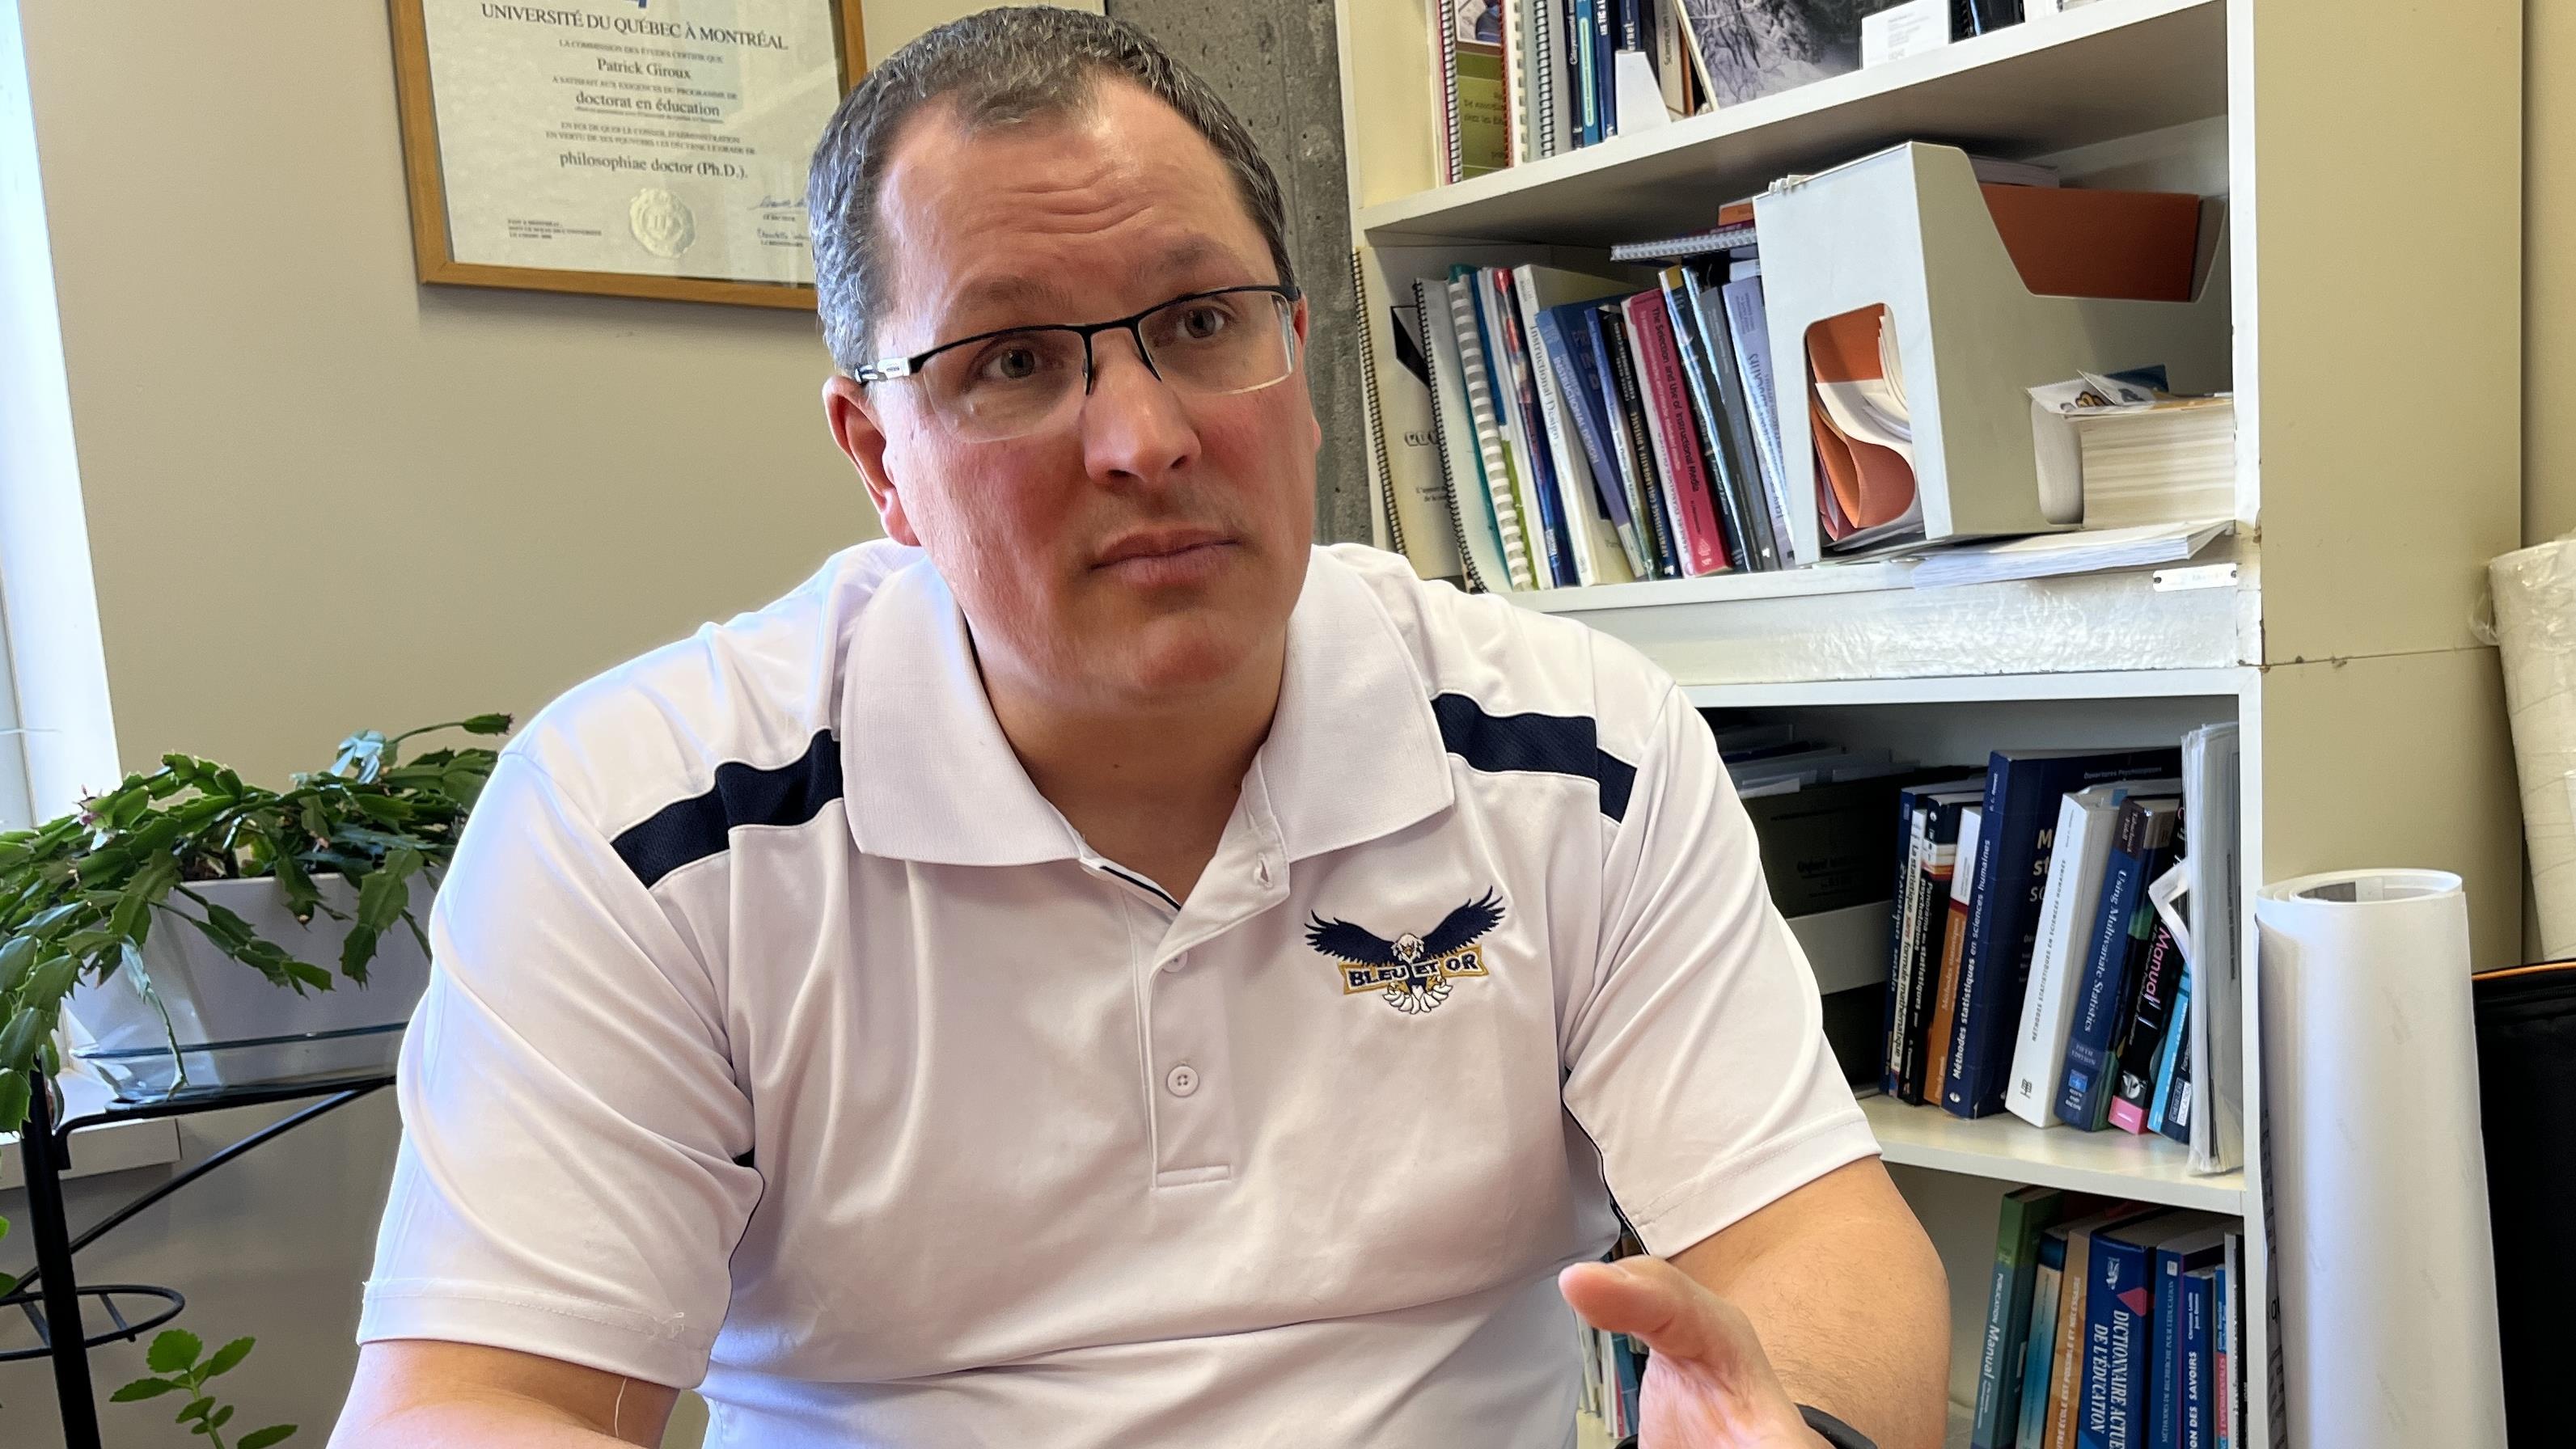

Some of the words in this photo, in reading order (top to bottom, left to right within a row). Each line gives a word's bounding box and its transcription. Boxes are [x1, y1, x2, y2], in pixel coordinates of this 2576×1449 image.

[482, 3, 585, 27] UNIVERSITÉ
[587, 15, 611, 29] DU
[614, 17, 682, 38] QUÉBEC
[685, 22, 697, 40] À
[700, 27, 789, 50] MONTRÉAL
[597, 58, 641, 76] Patrick
[646, 63, 692, 79] Giroux
[576, 91, 632, 108] doctorat
[636, 99, 652, 110] en
[656, 98, 720, 117] éducation
[560, 151, 647, 171] philosophiae
[650, 158, 692, 175] doctor
[696, 162, 748, 180] (Ph.D.).
[1650, 306, 1662, 323] The
[1653, 324, 1672, 362] Selection
[1527, 323, 1554, 395] Instructional
[1543, 400, 1563, 439] Design
[1664, 365, 1676, 382] and
[1668, 382, 1680, 399] Use
[1550, 357, 1587, 427] INSTRUCTIONAL
[1580, 429, 1600, 463] DESIGN
[1672, 399, 1681, 409] of
[1673, 412, 1695, 463] Instructional
[1686, 465, 1701, 492] Media
[1911, 844, 1918, 855] La
[2037, 828, 2053, 849] M
[1905, 858, 1918, 912] statistique
[1977, 839, 1990, 890] humaines
[2054, 860, 2066, 898] HUMAINES
[1922, 882, 1933, 932] Panorama
[2109, 869, 2127, 905] Using
[1914, 877, 1926, 951] psychologues
[1971, 893, 1983, 938] sciences
[2048, 900, 2060, 936] SCIENCES
[1900, 941, 1910, 981] formule
[1969, 940, 1977, 955] en
[2046, 938, 2053, 948] EN
[2093, 905, 2120, 978] Multivariate
[1349, 965, 1406, 987] BLEU
[1415, 961, 1440, 975] ET
[1445, 953, 1478, 971] OR
[1914, 945, 1927, 1009] statistiques
[2037, 950, 2052, 1001] STATISTIQUES
[2143, 927, 2172, 1003] Manual
[1958, 958, 1976, 1024] statistiques
[2082, 978, 2104, 1033] Statistics
[1893, 982, 1908, 1057] mathématique
[2030, 1003, 2043, 1041] MÉTHODES
[1951, 1025, 1967, 1079] Méthodes
[1991, 1273, 2003, 1324] PUBLICATION
[1984, 1324, 1999, 1378] Manual
[2093, 1323, 2109, 1344] DE
[2108, 1310, 2131, 1405] DICTIONNAIRE
[2188, 1351, 2197, 1400] SAVOIRS
[2090, 1346, 2109, 1434] L'ÉDUCATION
[2189, 1406, 2197, 1427] DES
[2189, 1430, 2197, 1449] ON
